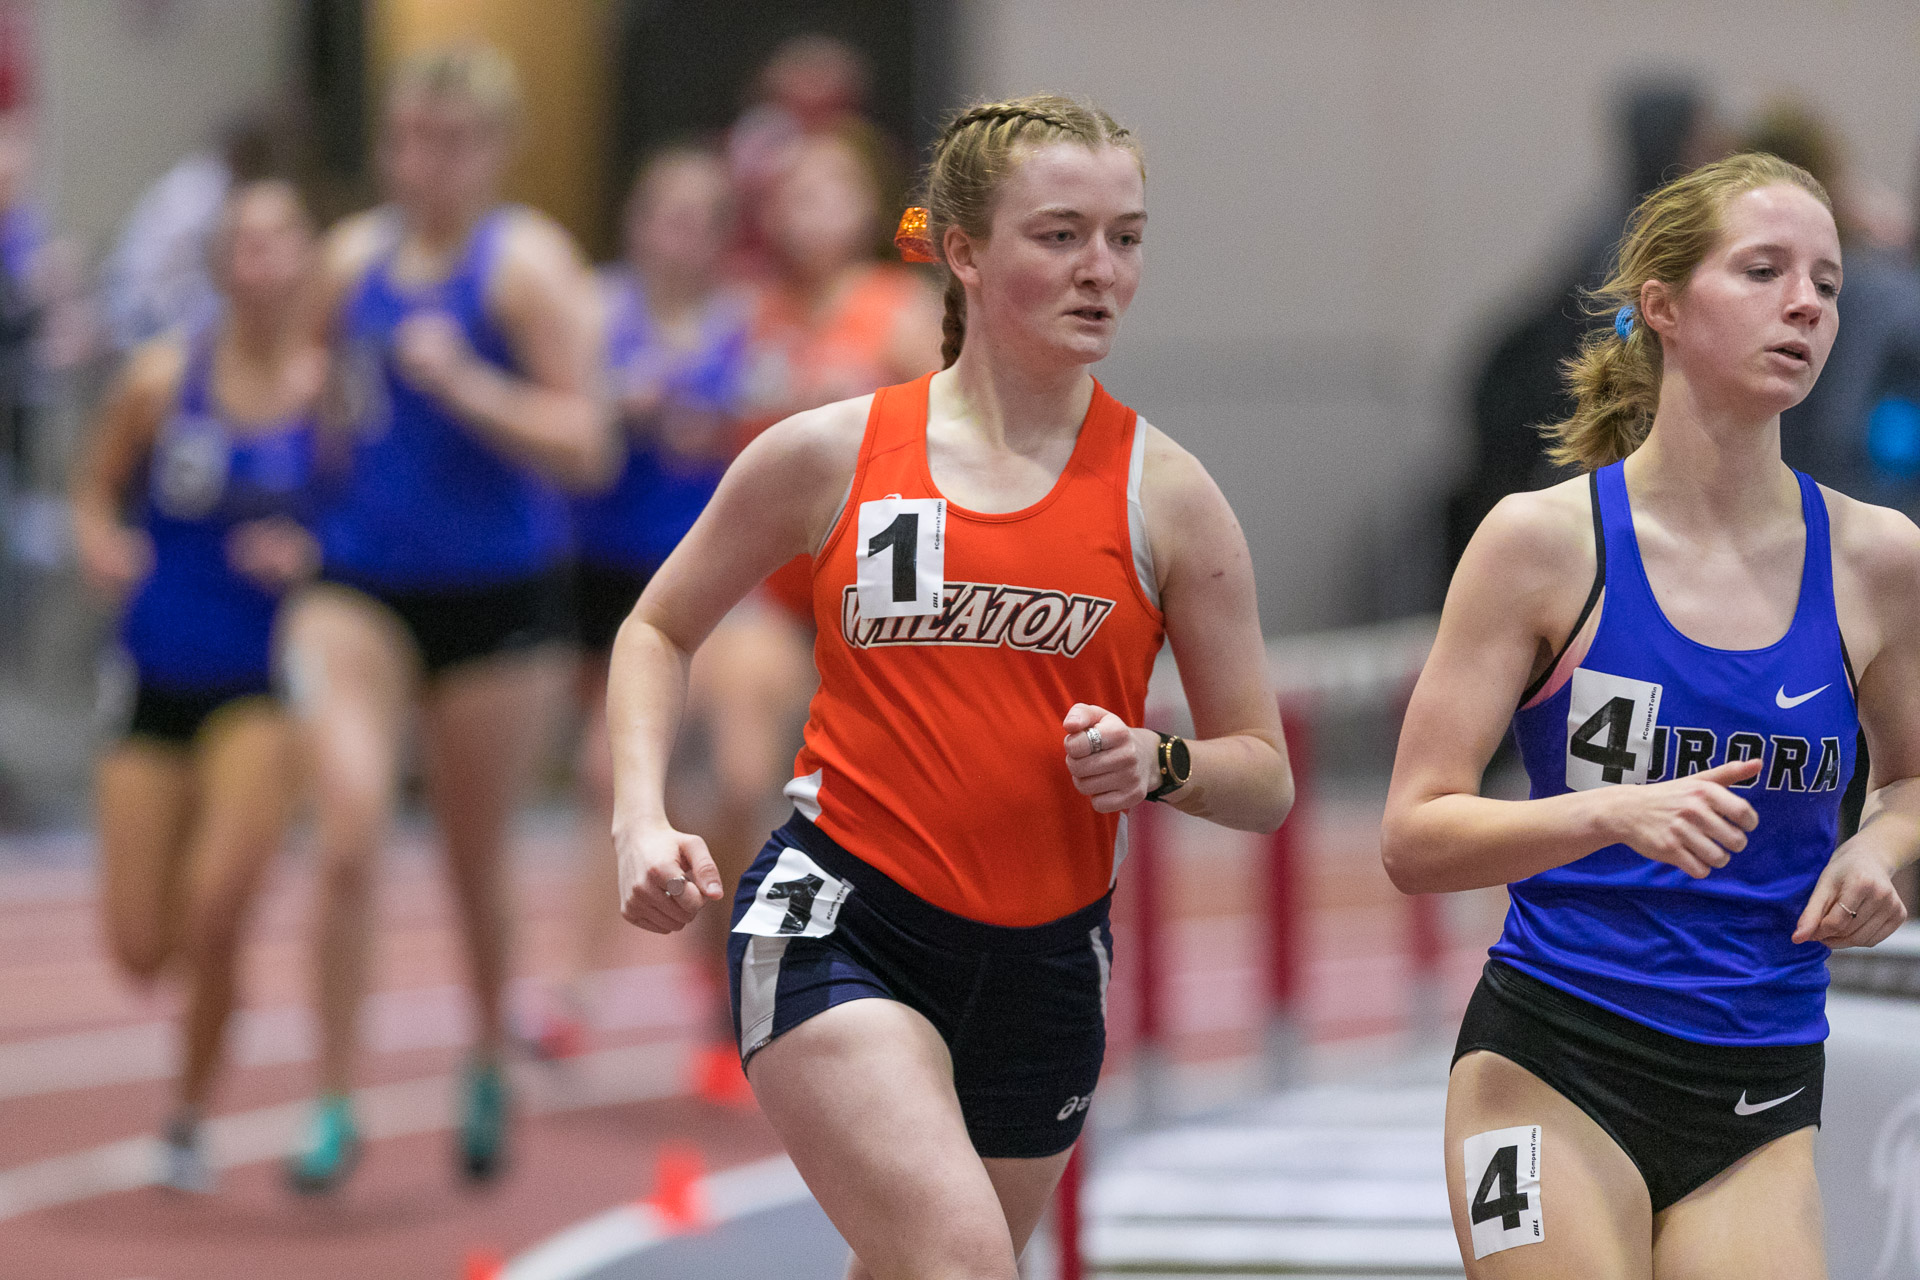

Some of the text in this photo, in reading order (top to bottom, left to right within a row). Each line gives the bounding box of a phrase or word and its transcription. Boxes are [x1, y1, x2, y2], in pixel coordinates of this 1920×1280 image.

[867, 513, 919, 603] 1
[1570, 695, 1637, 784] 4
[1642, 686, 1657, 741] #CompeteToWin
[766, 873, 825, 934] 1
[1471, 1145, 1529, 1231] 4
[1532, 1219, 1540, 1236] GILL
